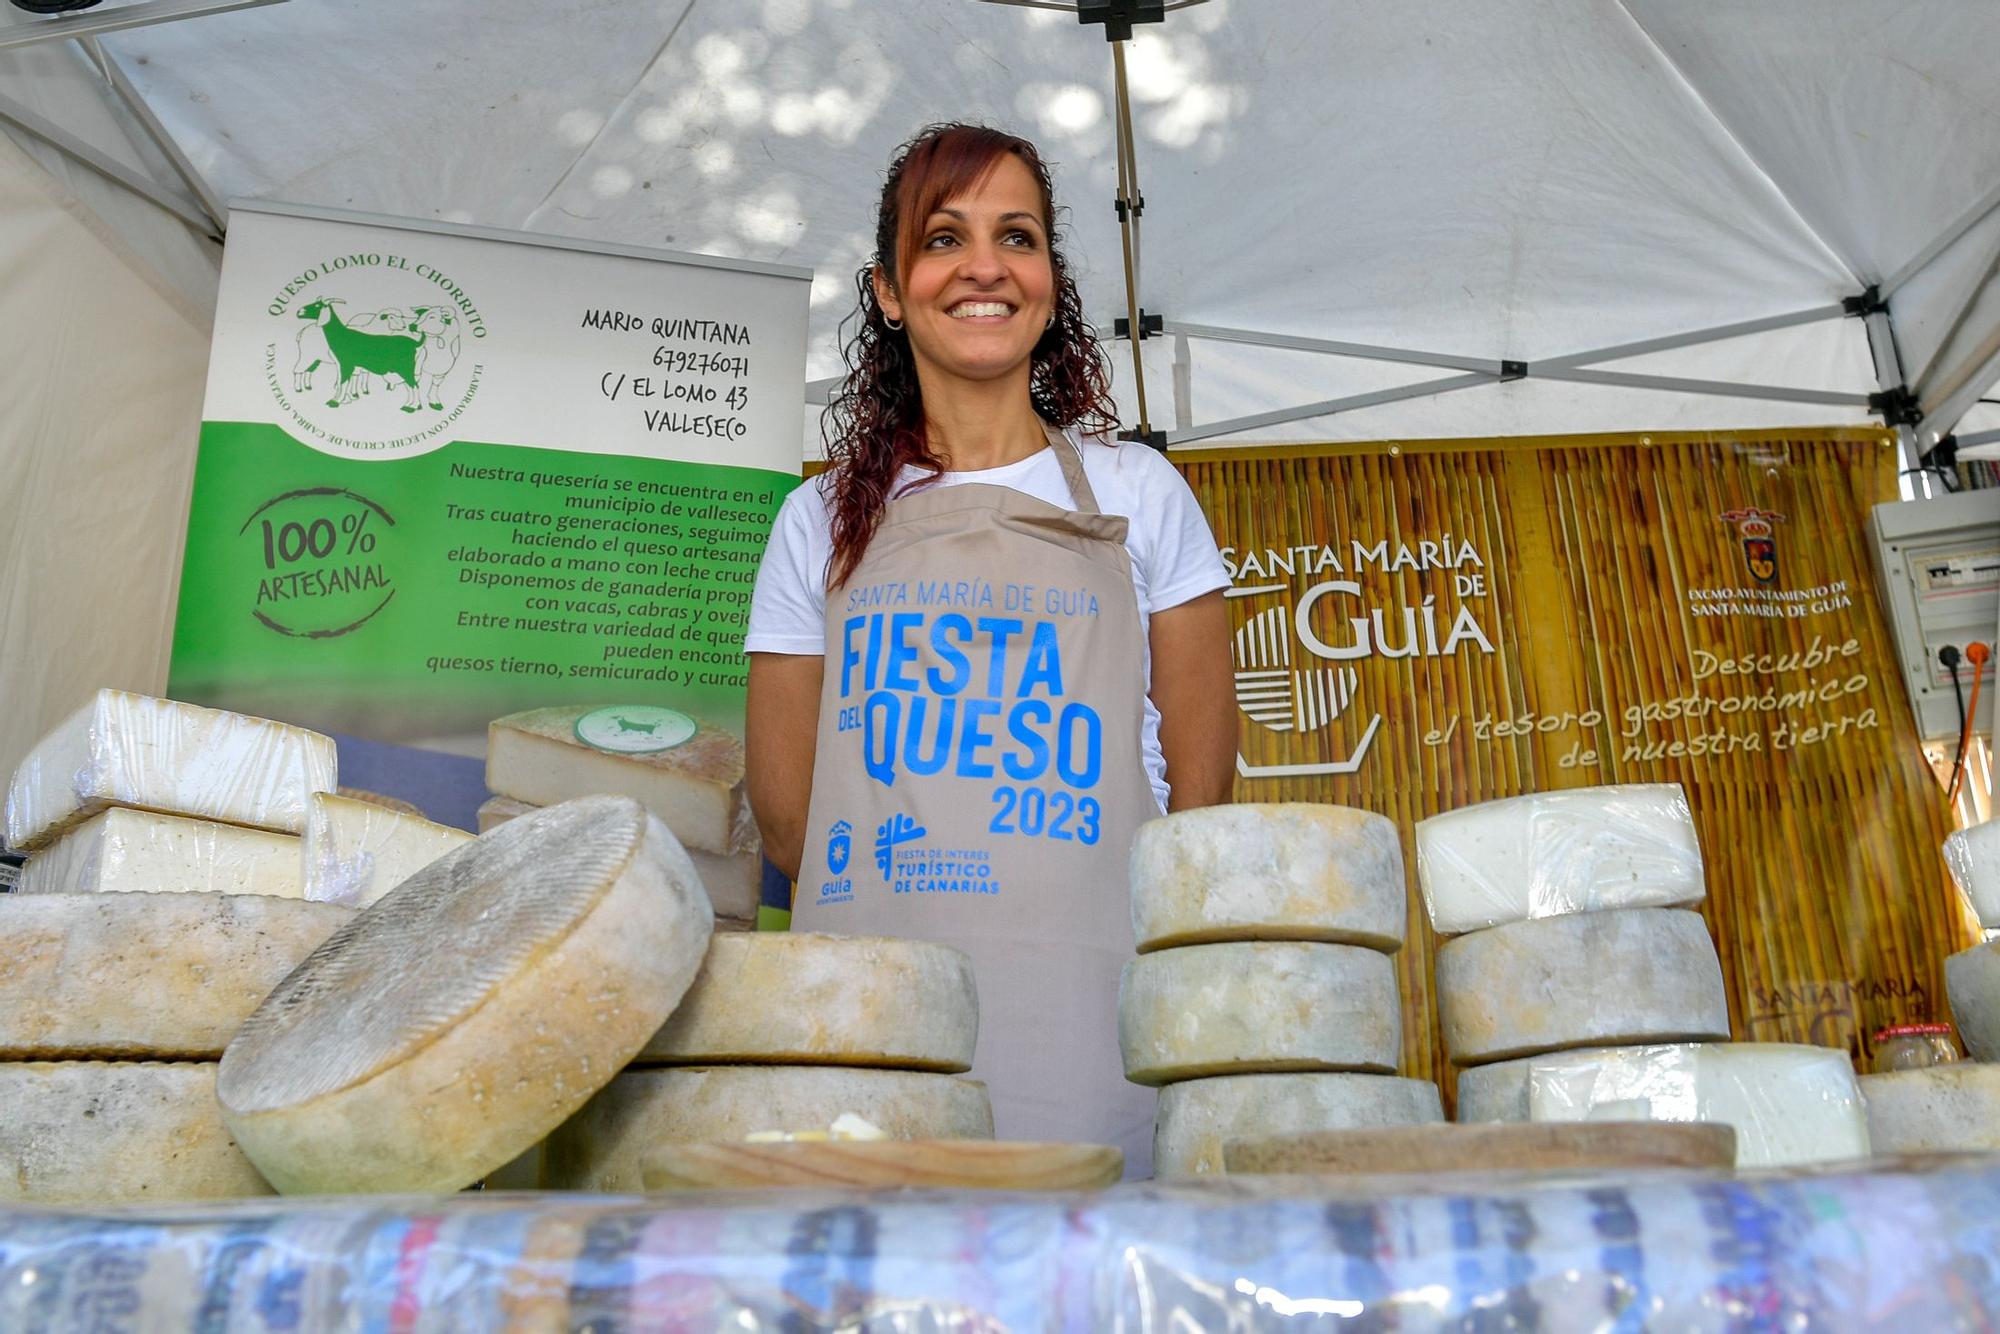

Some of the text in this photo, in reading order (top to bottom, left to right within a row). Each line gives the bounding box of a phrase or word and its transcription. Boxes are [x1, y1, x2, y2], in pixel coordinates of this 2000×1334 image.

[268, 253, 487, 339] QUESO LOMO EL CHORRITO
[581, 309, 750, 345] MARIO QUINTANA
[652, 346, 748, 378] 679276071
[448, 364, 483, 422] ELABORADO
[601, 372, 748, 410] C/ EL LOMO 43
[328, 436, 343, 446] DE
[389, 432, 427, 449] LECHE
[427, 420, 449, 436] CON
[644, 410, 746, 441] VALLESECO
[345, 439, 385, 450] CRUDA
[450, 463, 774, 505] Nuestra quesería se encuentra en el
[446, 504, 485, 520] Tras
[490, 510, 552, 526] cuatro
[556, 515, 683, 539] generaciones,
[565, 495, 773, 525] municipio de valleseco.
[262, 509, 376, 569] 100%
[511, 528, 765, 564] haciendo el queso artesana
[1219, 533, 1485, 579] SANTA MARÍA
[448, 546, 545, 567] elaborado
[551, 558, 562, 568] a
[567, 558, 620, 573] mano
[625, 562, 658, 576] con
[664, 561, 711, 580] leche
[257, 564, 391, 605] ARTESANAL
[459, 568, 576, 589] Disponemos
[581, 577, 604, 592] de
[608, 580, 702, 600] ganadería
[847, 577, 1100, 619] SANTA MARÍA DE GUÍA
[1455, 574, 1487, 598] DE
[525, 597, 559, 610] con
[565, 600, 621, 617] vacas,
[627, 602, 688, 619] cabras
[693, 610, 703, 624] y
[1295, 579, 1496, 660] GUÍA
[1691, 594, 1852, 618] SANTA MARÍA DE GUÍA
[457, 611, 510, 628] Entre
[514, 617, 587, 634] nuestra
[593, 621, 675, 639] variedad
[680, 625, 702, 641] de
[603, 643, 673, 661] pueden
[841, 613, 1064, 698] FIESTA
[1693, 635, 1860, 680] Descubre
[426, 655, 494, 673] quesos
[500, 657, 563, 679] tierno,
[568, 663, 679, 682] semicurado
[683, 672, 695, 687] y
[1424, 674, 1868, 746] el tesoro gastronómico
[838, 690, 1101, 789] DEL QUESO
[1558, 708, 1878, 769] de nuestra tierra
[989, 786, 1100, 846] 2023
[896, 849, 926, 860] FIESTA
[929, 848, 942, 859] DE
[897, 859, 991, 878] TURÍSTICO
[895, 879, 1000, 895] DE CANARIAS
